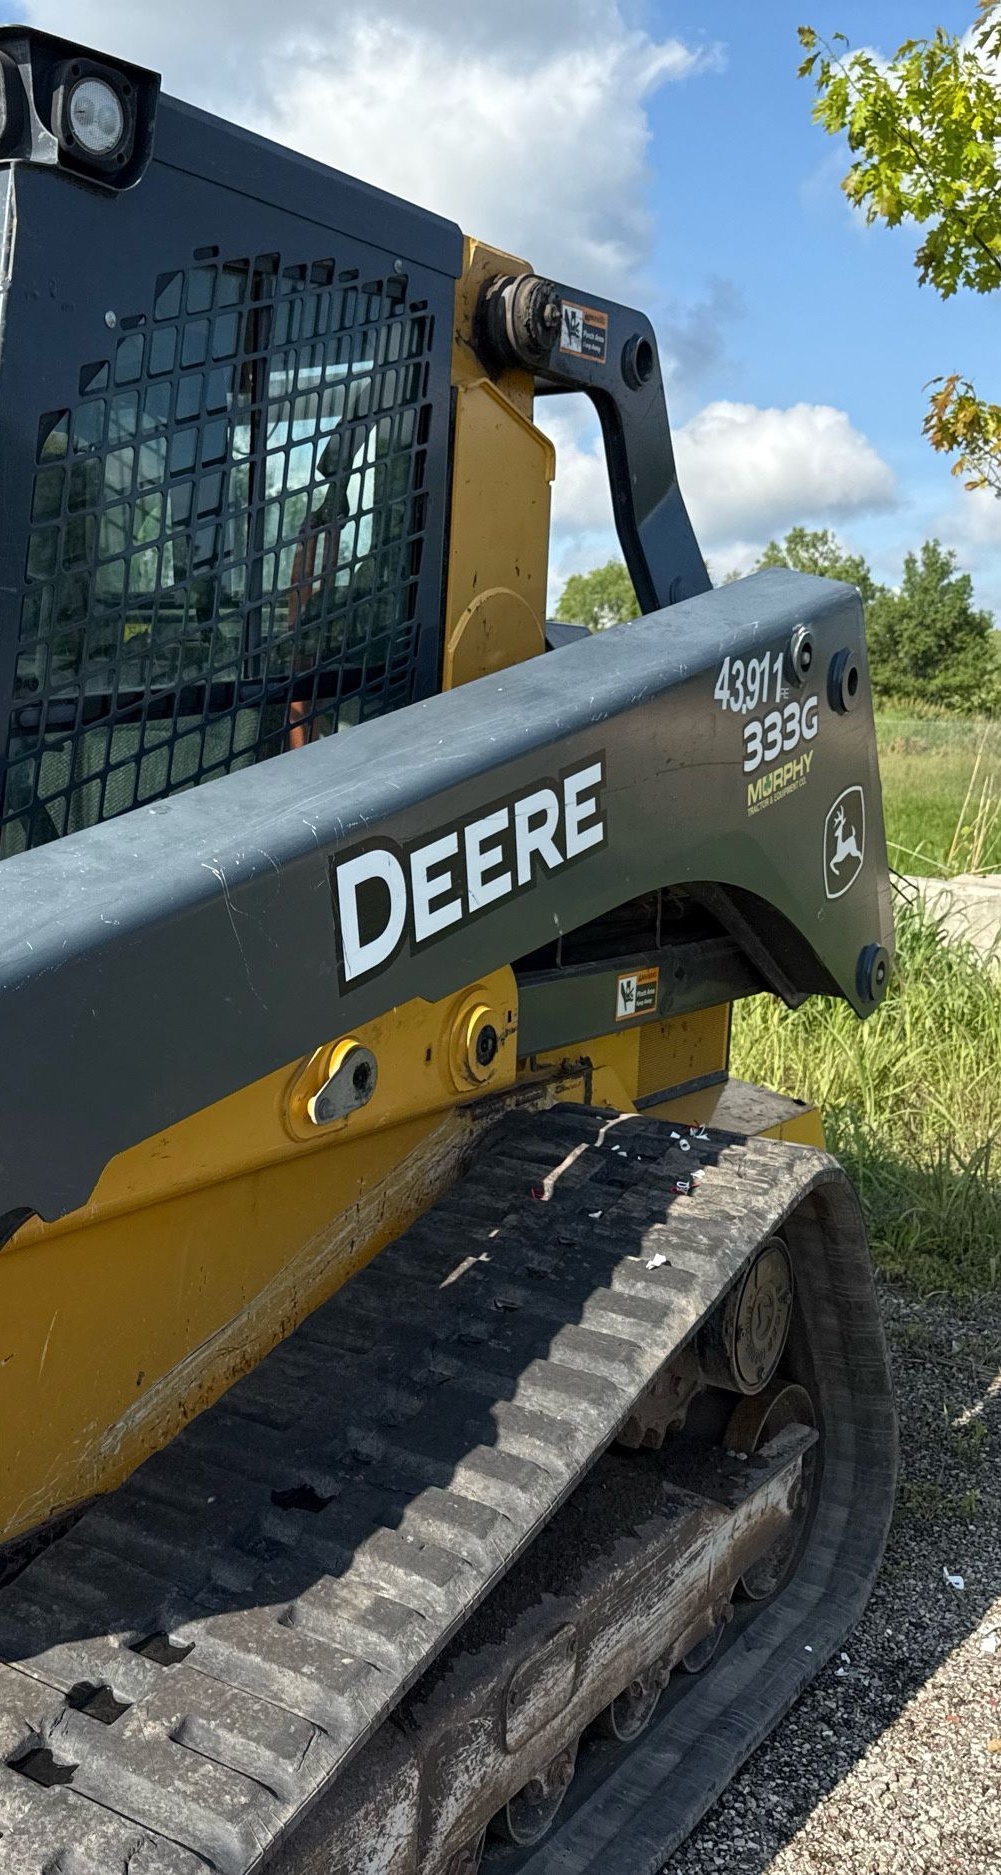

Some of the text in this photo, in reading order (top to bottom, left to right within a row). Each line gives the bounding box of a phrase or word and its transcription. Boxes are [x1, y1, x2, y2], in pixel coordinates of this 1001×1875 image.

[743, 695, 818, 773] 333G
[748, 750, 814, 806] MURPHY
[336, 762, 604, 982] DEERE
